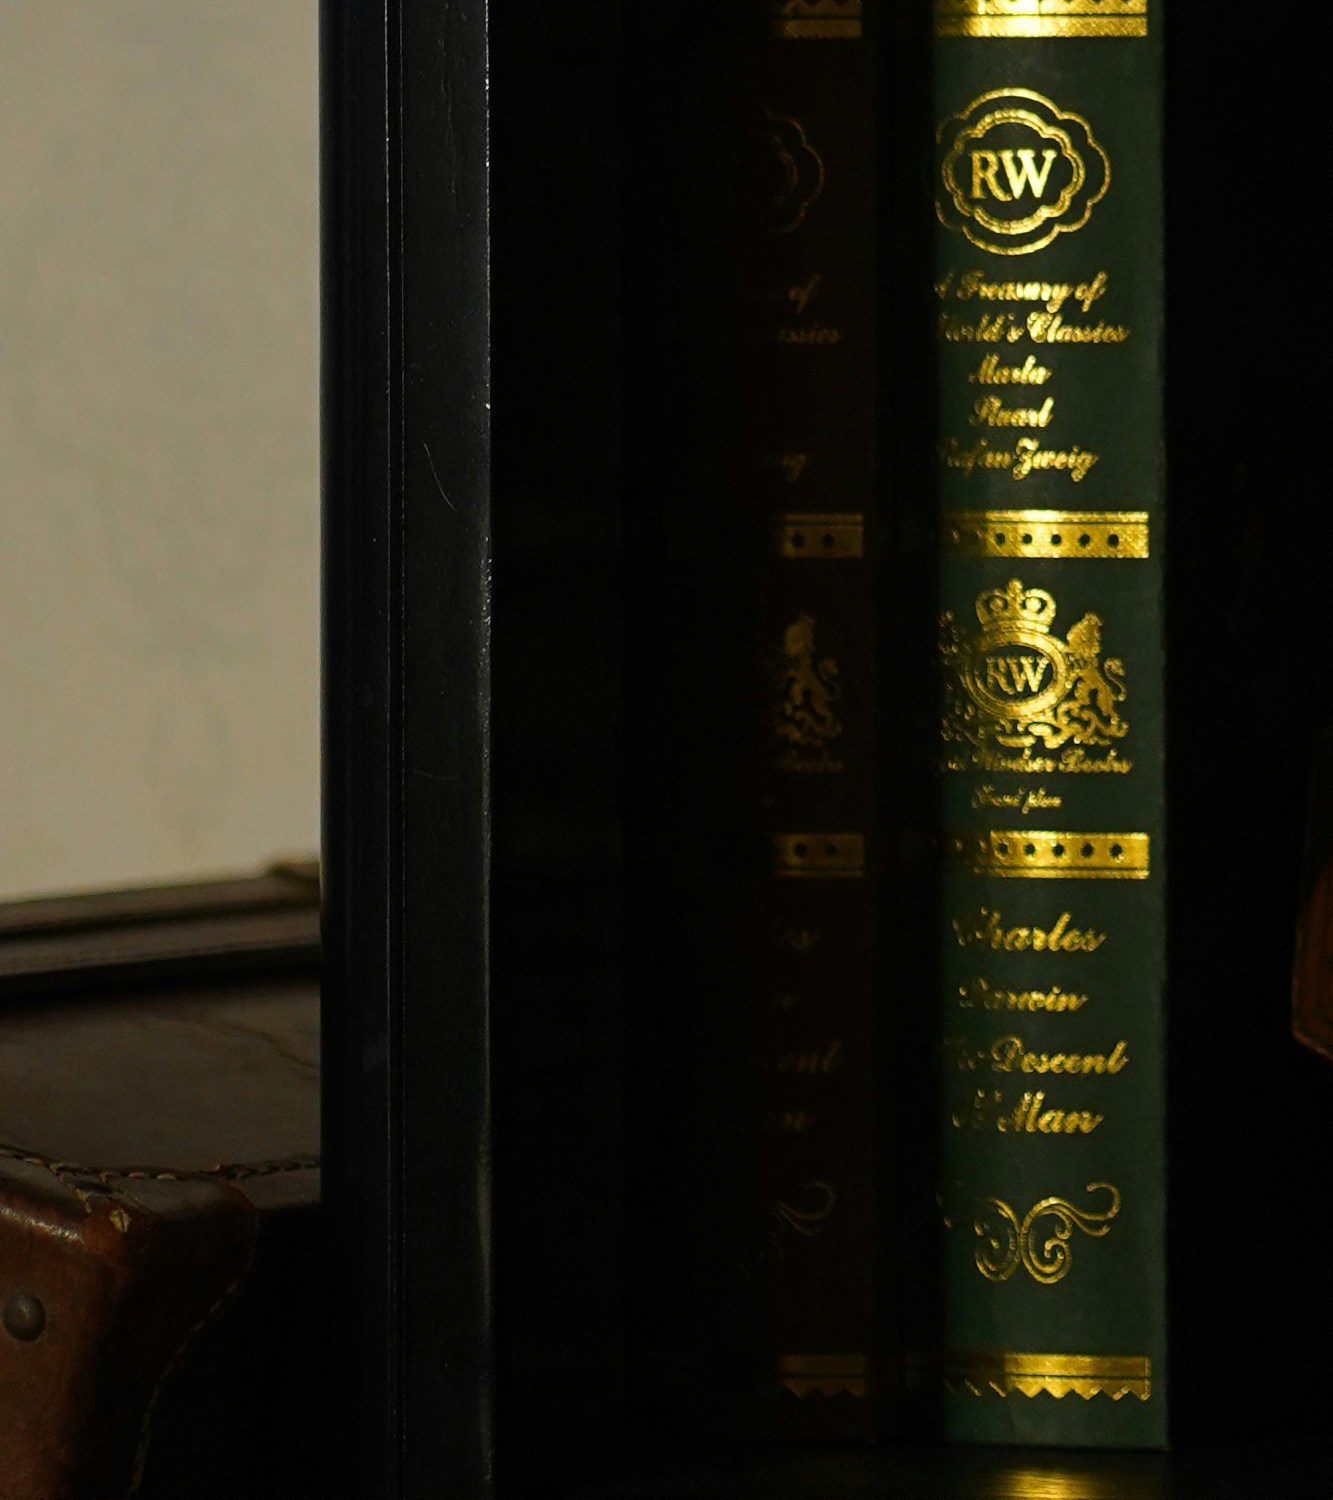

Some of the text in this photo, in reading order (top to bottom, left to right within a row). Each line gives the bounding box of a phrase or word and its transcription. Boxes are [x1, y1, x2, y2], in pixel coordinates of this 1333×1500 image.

[969, 147, 1059, 200] RW
[1075, 270, 1108, 312] of
[939, 311, 1132, 344] orld's Classics
[1013, 436, 1100, 482] Zweig
[985, 655, 1050, 695] RW
[991, 1034, 1132, 1075] Descent
[997, 1089, 1106, 1134] Man
